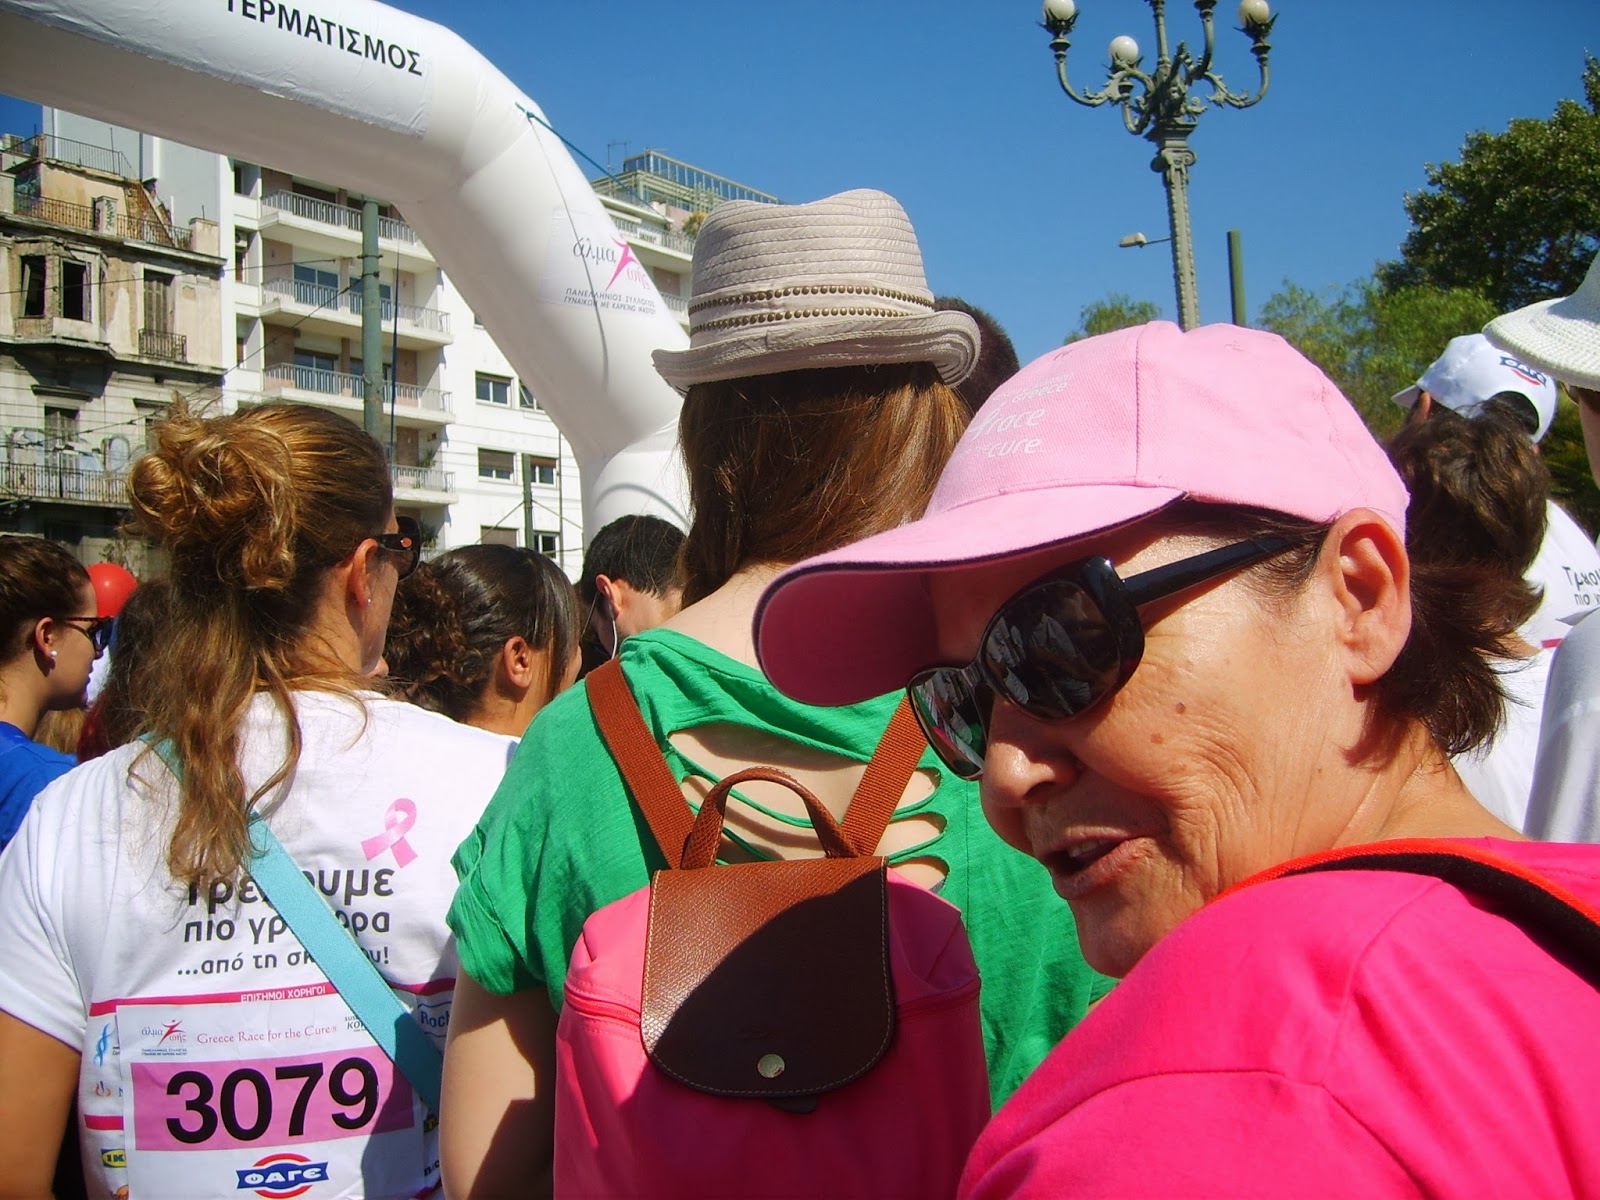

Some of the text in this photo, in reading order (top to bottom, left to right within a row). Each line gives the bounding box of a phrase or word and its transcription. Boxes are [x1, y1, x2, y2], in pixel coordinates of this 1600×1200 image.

[573, 238, 616, 265] άλμα
[184, 909, 391, 945] πιο γρορα
[252, 953, 278, 969] τη
[240, 985, 326, 1003] ΕΠΙΣΗΜΟΙ ΧΟΡΗΓΟΙ
[196, 1032, 234, 1045] Greece
[237, 1029, 265, 1042] Race
[267, 1028, 281, 1042] for
[284, 1027, 301, 1039] the
[166, 1057, 379, 1143] 3079
